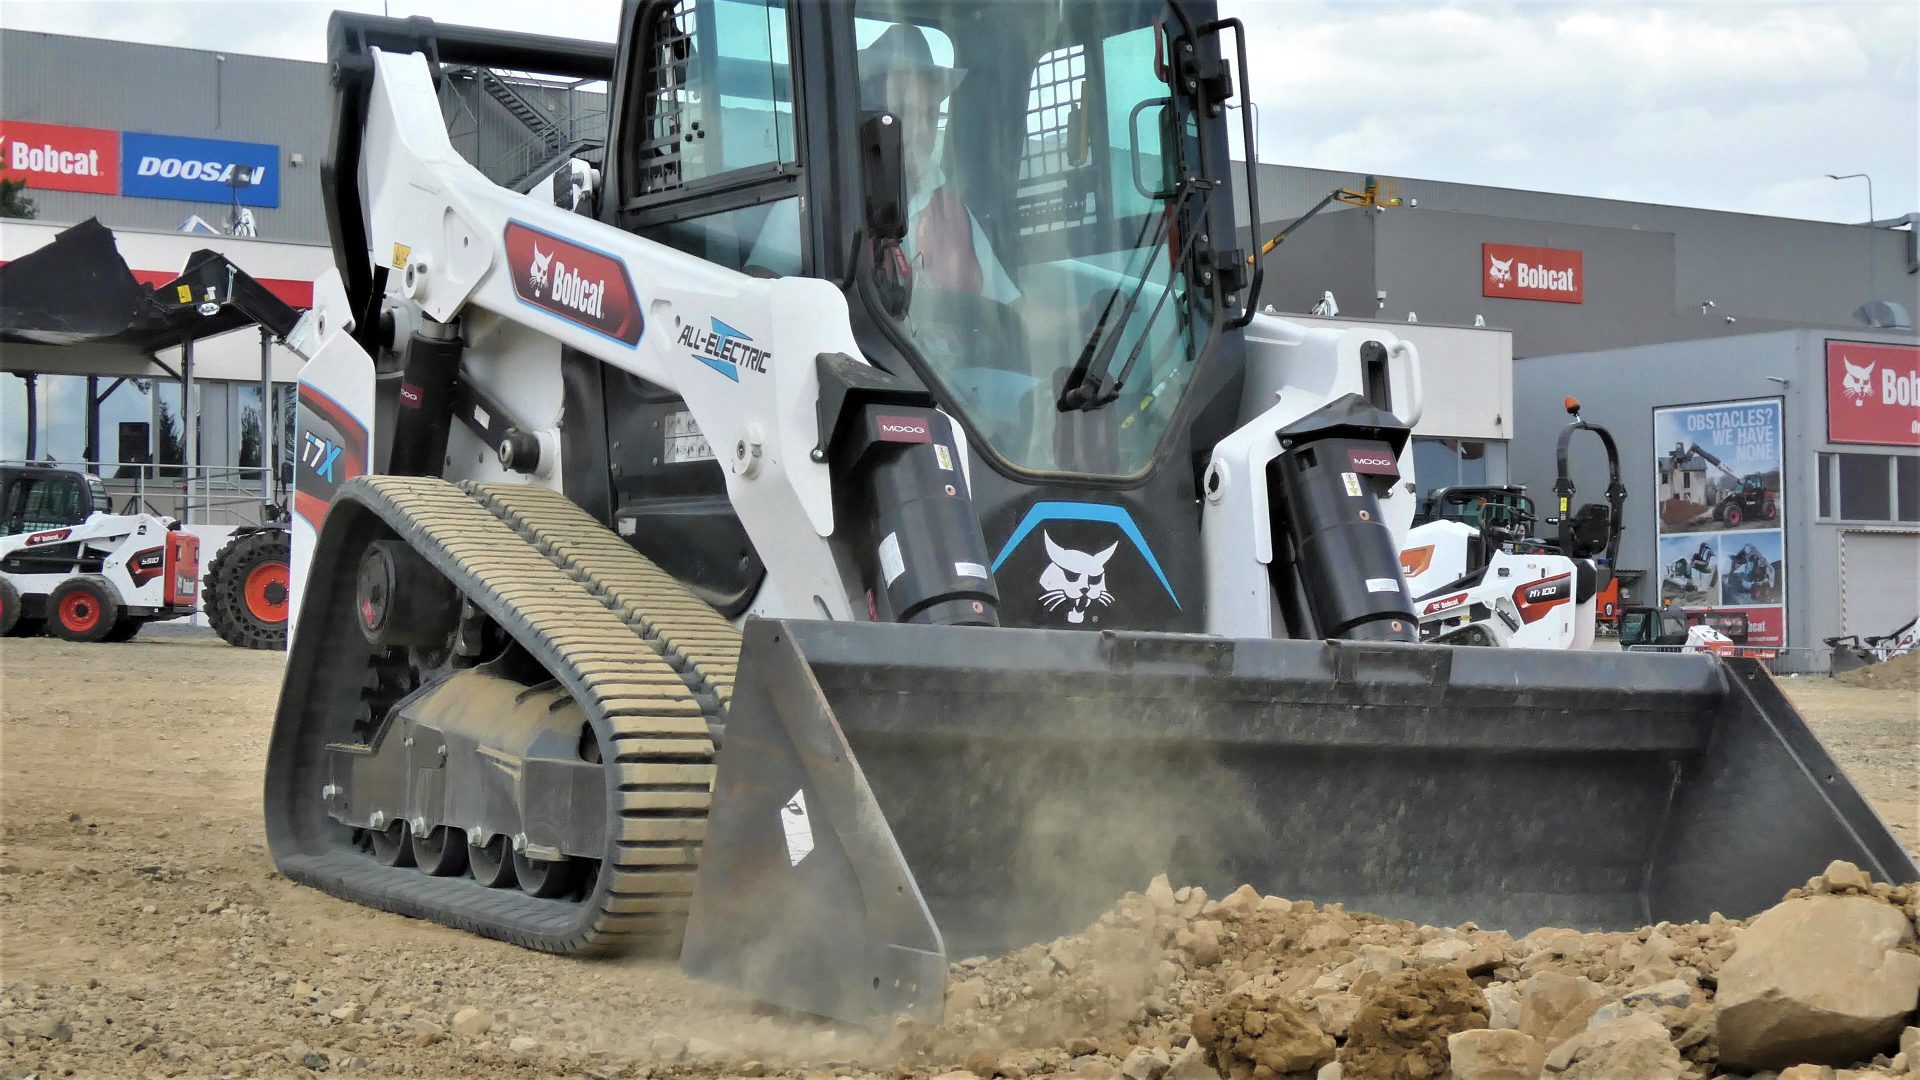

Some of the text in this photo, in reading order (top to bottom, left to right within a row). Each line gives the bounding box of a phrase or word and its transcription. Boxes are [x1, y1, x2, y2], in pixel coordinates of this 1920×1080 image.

[12, 141, 99, 177] Bobcat
[1517, 262, 1574, 291] Bobcat
[551, 261, 605, 319] Bobcat
[882, 424, 925, 434] MOOG
[1687, 407, 1773, 432] OBSTACLES?
[1712, 425, 1773, 446] WE HAVE
[1353, 457, 1391, 466] MOOG
[1735, 442, 1774, 461] NONE
